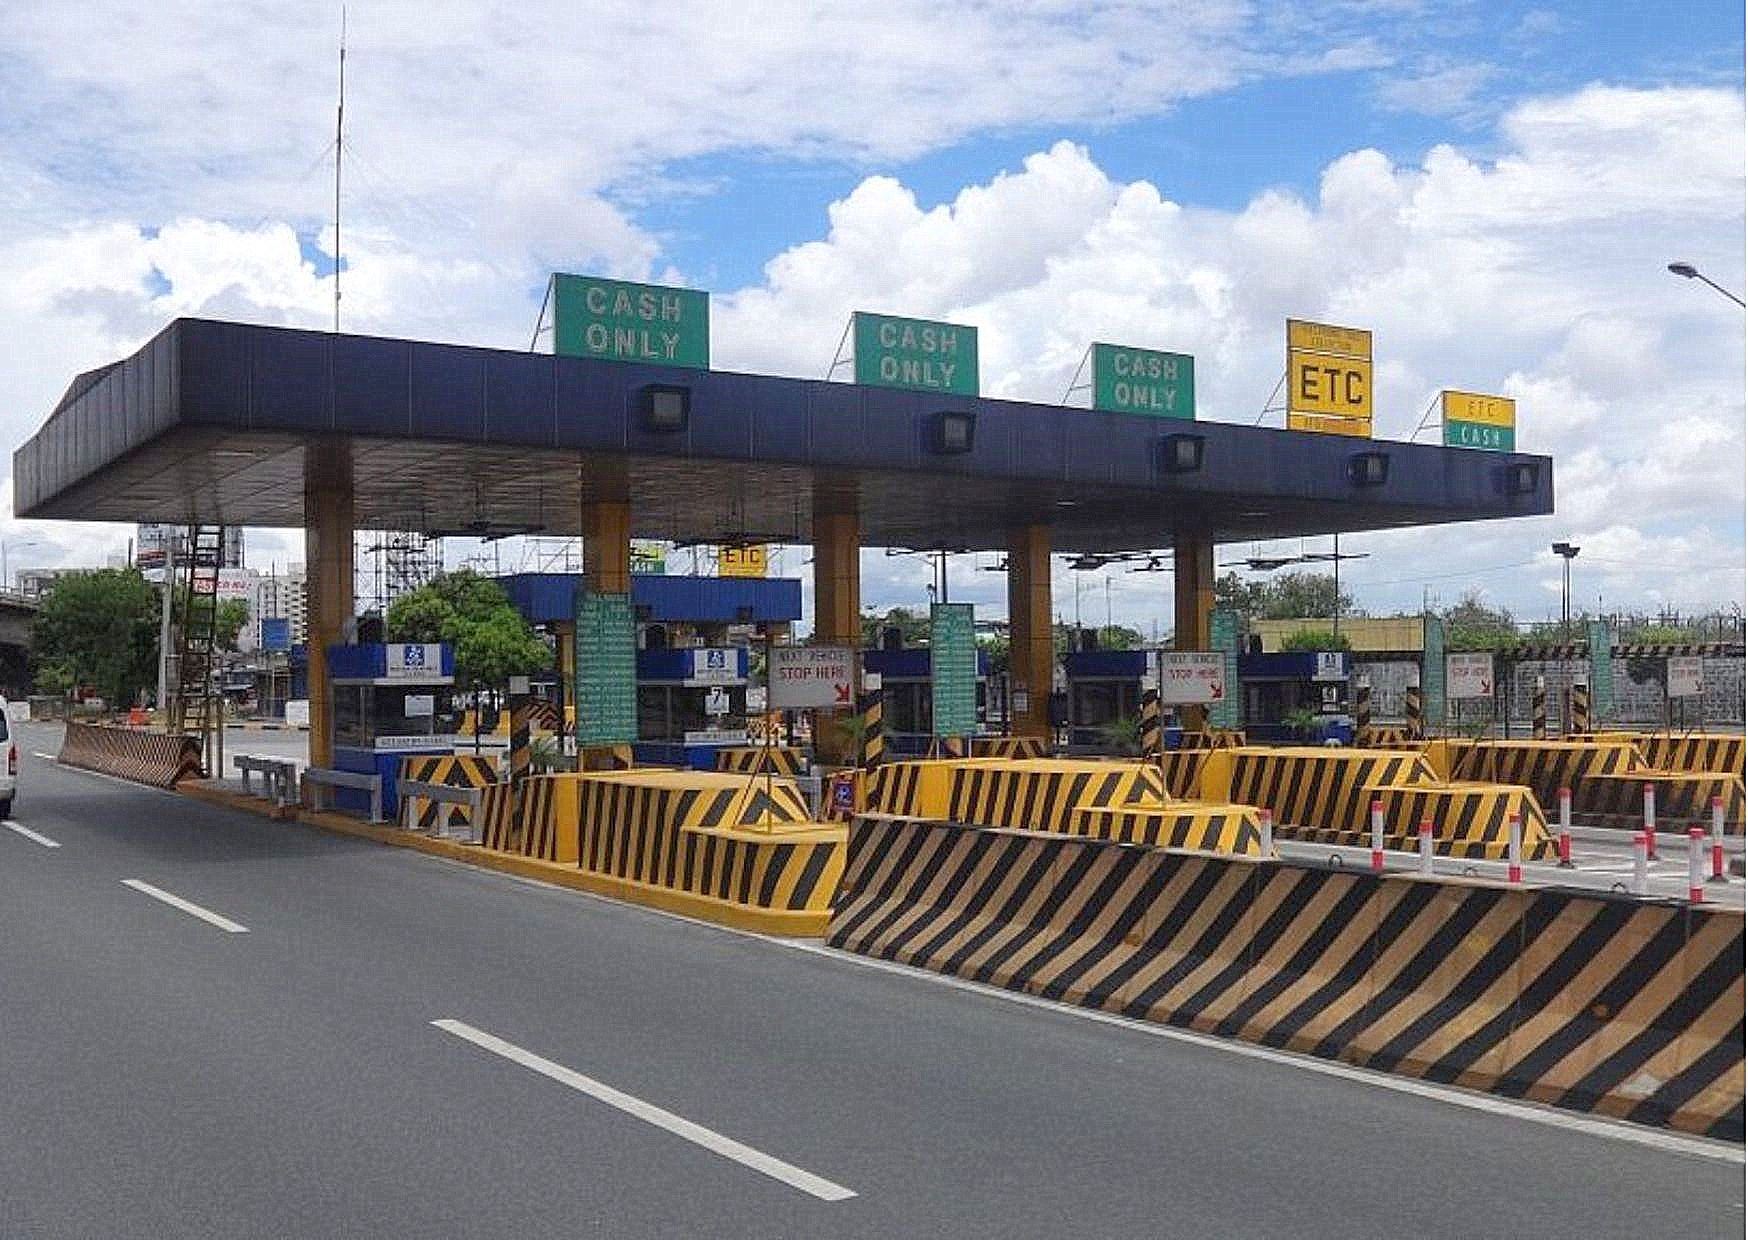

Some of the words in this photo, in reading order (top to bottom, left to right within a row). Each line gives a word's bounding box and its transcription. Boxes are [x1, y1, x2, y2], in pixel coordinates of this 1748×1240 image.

[586, 286, 681, 322] CASH
[586, 323, 681, 360] ONLY
[880, 322, 957, 354] CASH
[880, 355, 956, 388] ONLY
[1113, 353, 1177, 380] CASH
[1114, 382, 1177, 410] ONLY
[1301, 364, 1362, 404] ETC
[1466, 400, 1499, 417] ETC
[1461, 425, 1500, 447] CASH
[723, 547, 761, 563] ETC
[779, 666, 812, 680] STOP
[815, 666, 847, 680] HERE
[713, 688, 721, 705] 7
